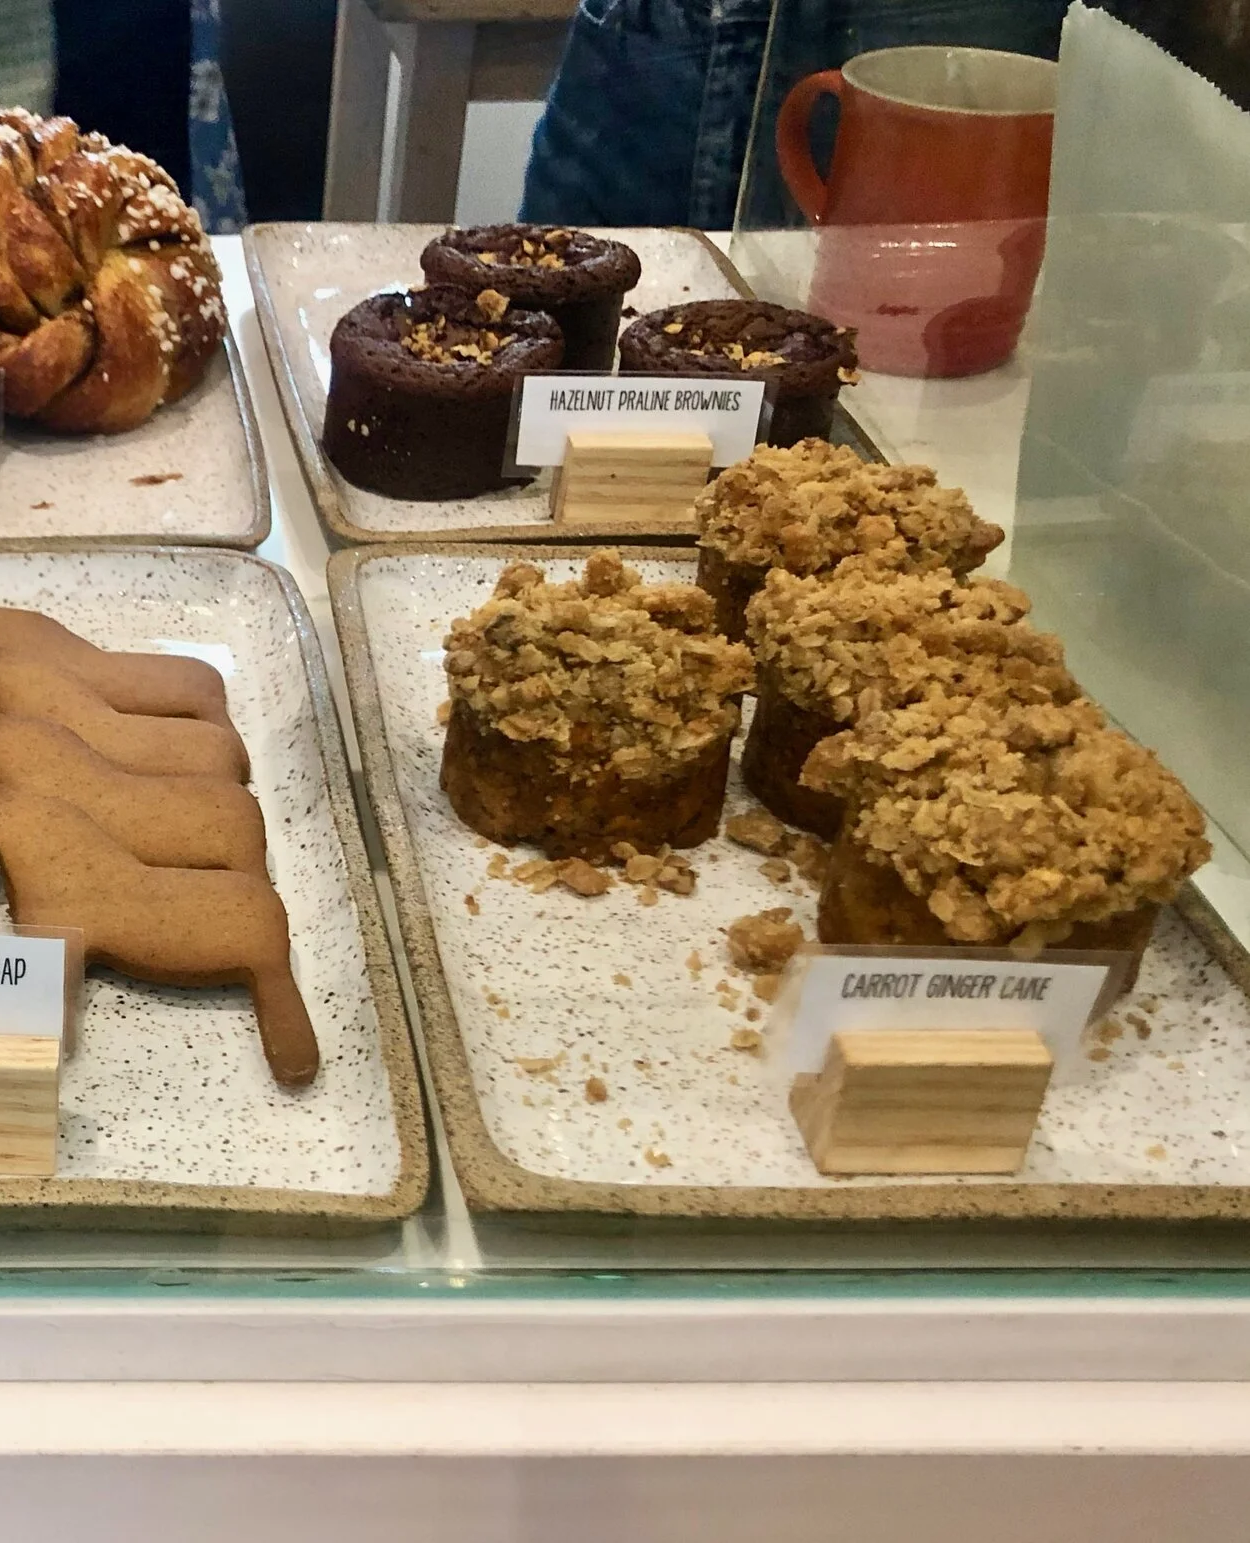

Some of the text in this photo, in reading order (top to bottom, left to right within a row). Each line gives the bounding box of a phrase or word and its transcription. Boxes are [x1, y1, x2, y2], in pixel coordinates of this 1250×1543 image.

[550, 389, 742, 412] HAZELNUT PRALINE BROWNIES
[841, 973, 1053, 1000] CARROT GINGER CAKE
